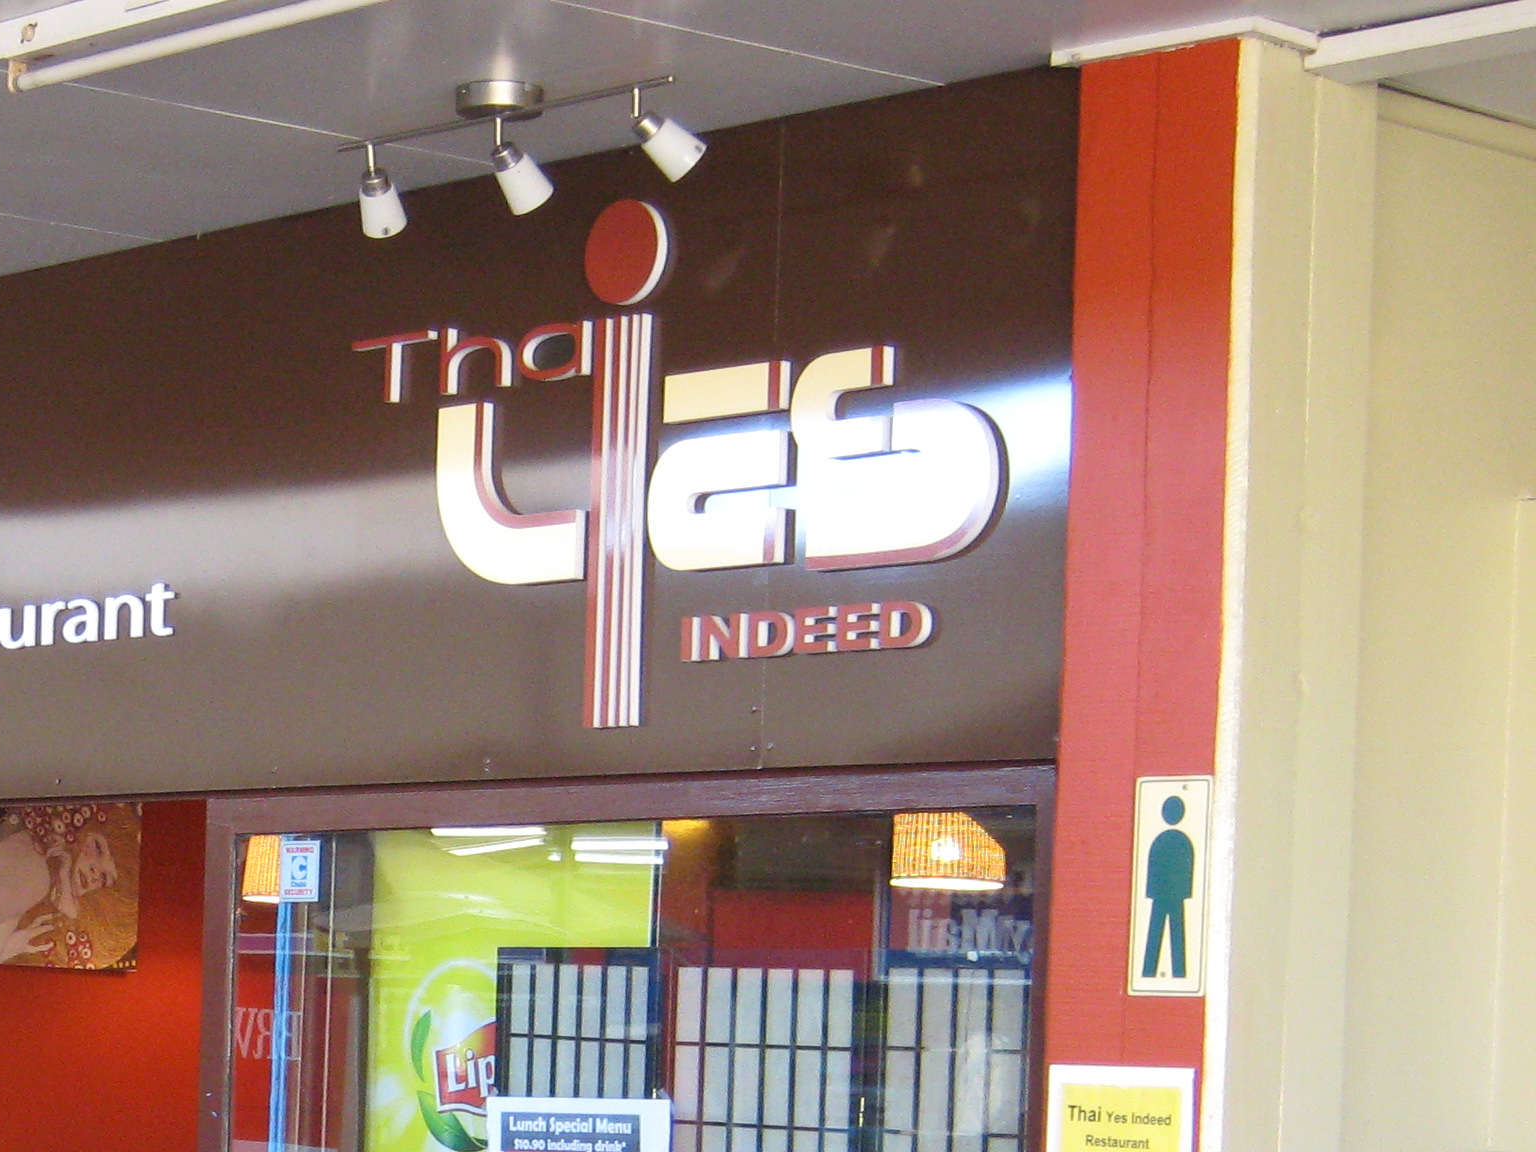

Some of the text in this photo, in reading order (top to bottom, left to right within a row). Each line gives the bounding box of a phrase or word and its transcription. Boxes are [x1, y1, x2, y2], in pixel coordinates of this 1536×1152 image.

[680, 601, 935, 662] INDEED
[508, 1115, 633, 1136] Lunch Special Menu
[1067, 1104, 1172, 1127] Thai Yes Indeed
[513, 1137, 546, 1151] $10.90
[1085, 1134, 1150, 1150] Restaurant
